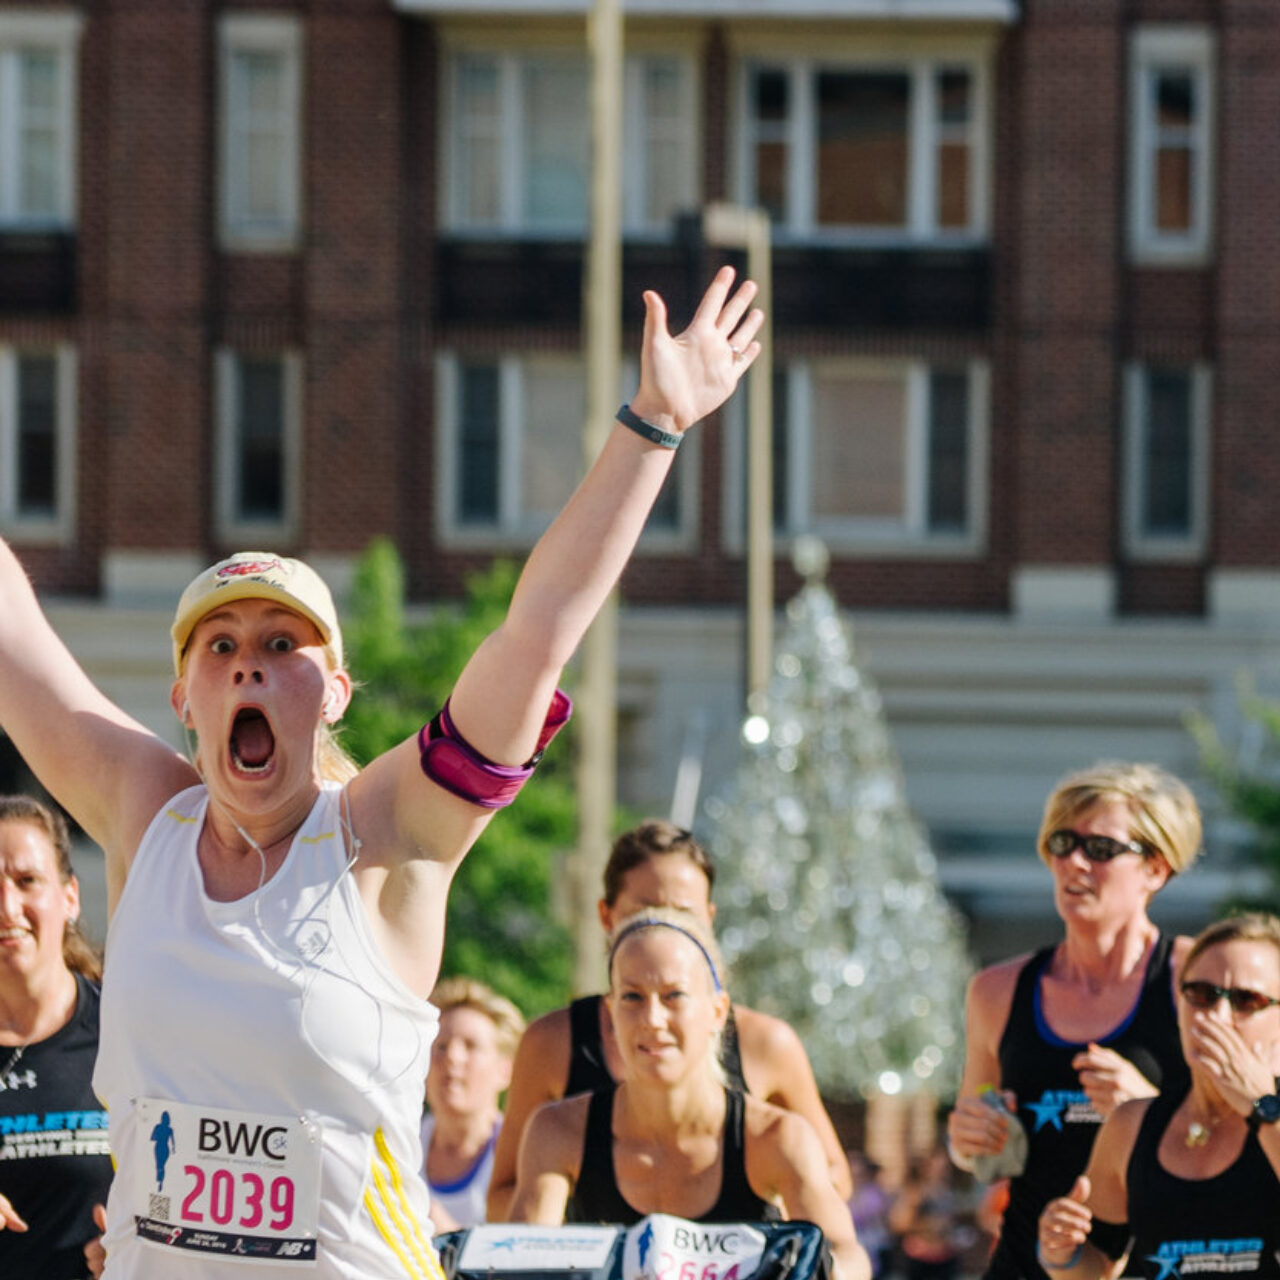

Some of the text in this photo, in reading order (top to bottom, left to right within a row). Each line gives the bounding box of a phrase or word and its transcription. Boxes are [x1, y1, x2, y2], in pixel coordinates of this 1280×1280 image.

[199, 1118, 288, 1161] BWC
[181, 1165, 295, 1231] 2039
[675, 1228, 739, 1254] BWC
